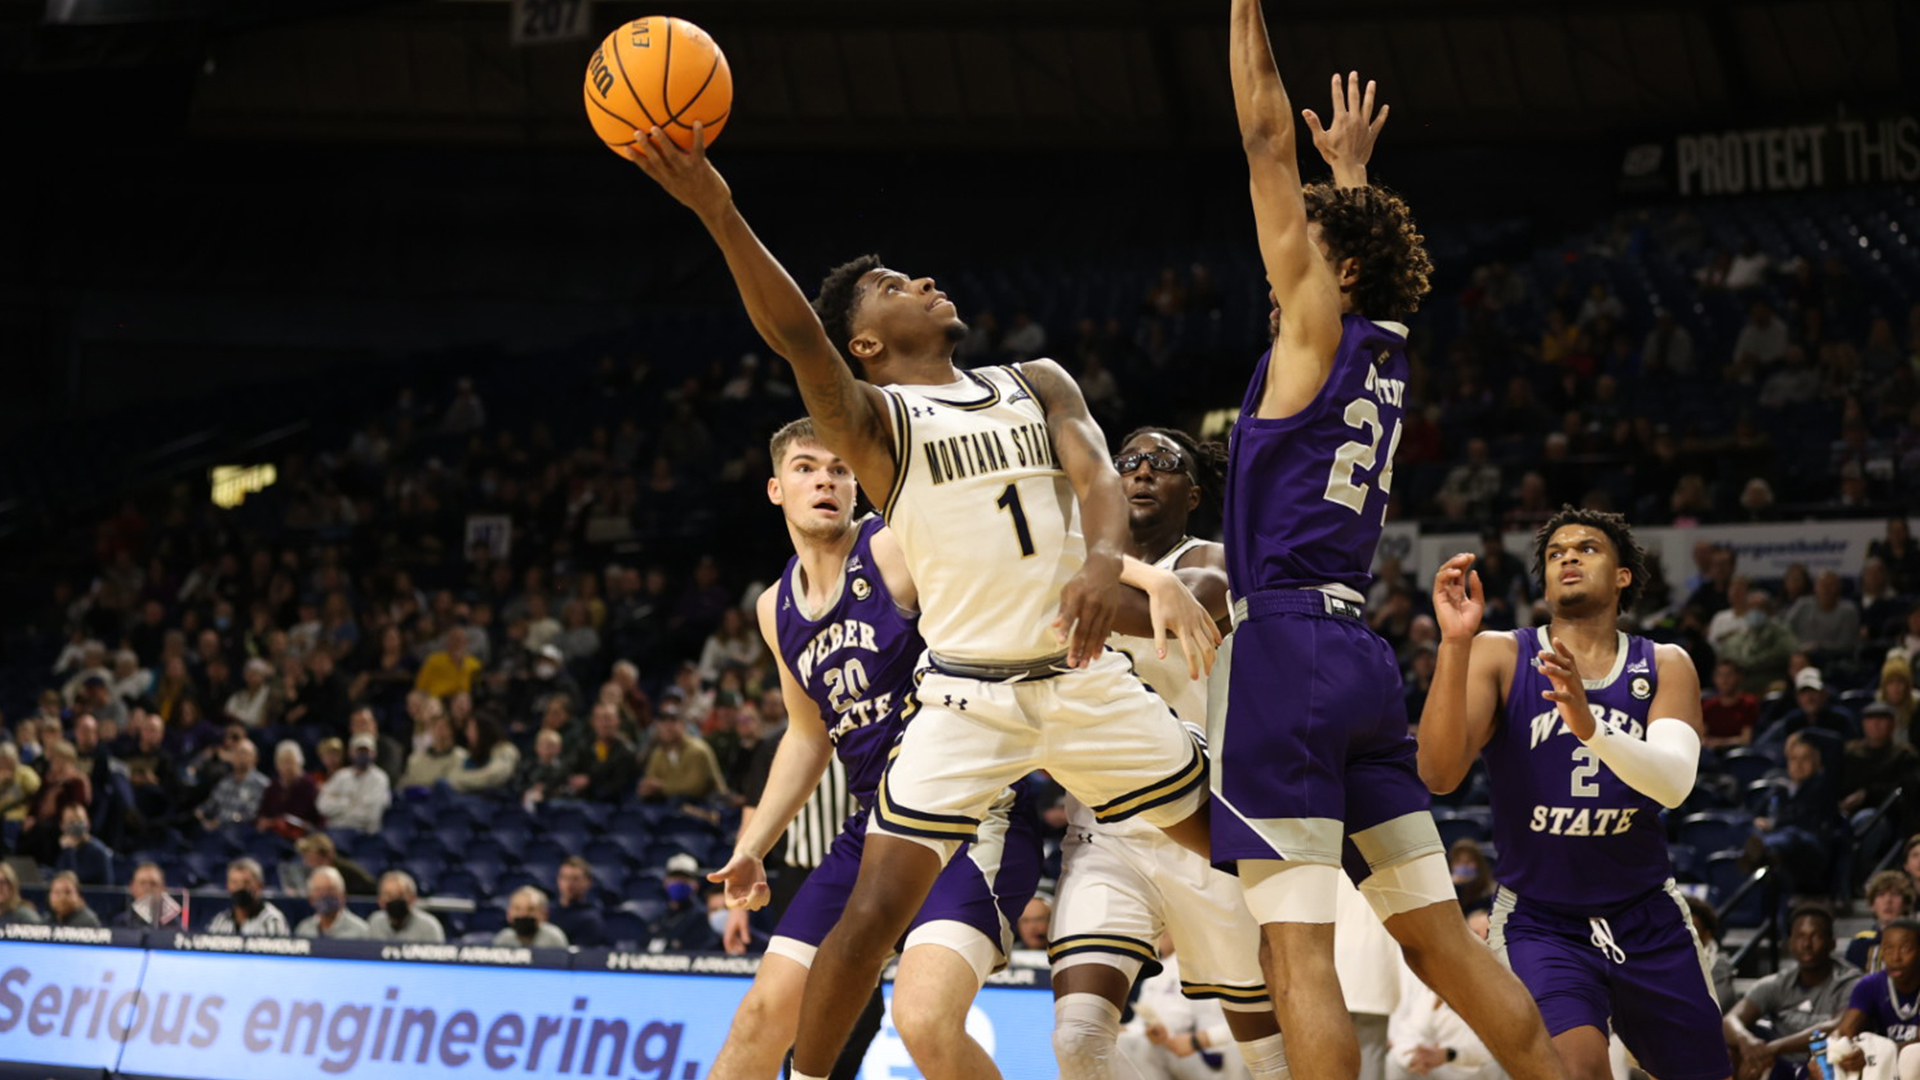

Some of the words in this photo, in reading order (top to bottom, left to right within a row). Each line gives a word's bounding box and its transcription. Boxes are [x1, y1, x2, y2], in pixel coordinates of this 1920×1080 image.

[1676, 127, 1827, 196] PROTECT
[1836, 117, 1919, 184] THIS
[924, 430, 1009, 485] MONTANA
[1011, 422, 1052, 467] STAT
[996, 482, 1037, 559] 1
[797, 618, 880, 690] WEBER
[823, 657, 870, 714] 20
[1570, 746, 1600, 798] 2
[1529, 805, 1640, 837] STATE
[5, 923, 52, 940] UNDER
[53, 926, 112, 944] ARMOUR
[193, 935, 243, 951] UNDER
[245, 937, 311, 955] ARMOUR
[402, 944, 458, 961] UNDER
[459, 947, 532, 965] ARMOUR
[629, 953, 691, 971] UNDER
[0, 966, 226, 1049] Serious
[243, 987, 701, 1080] engineering.
